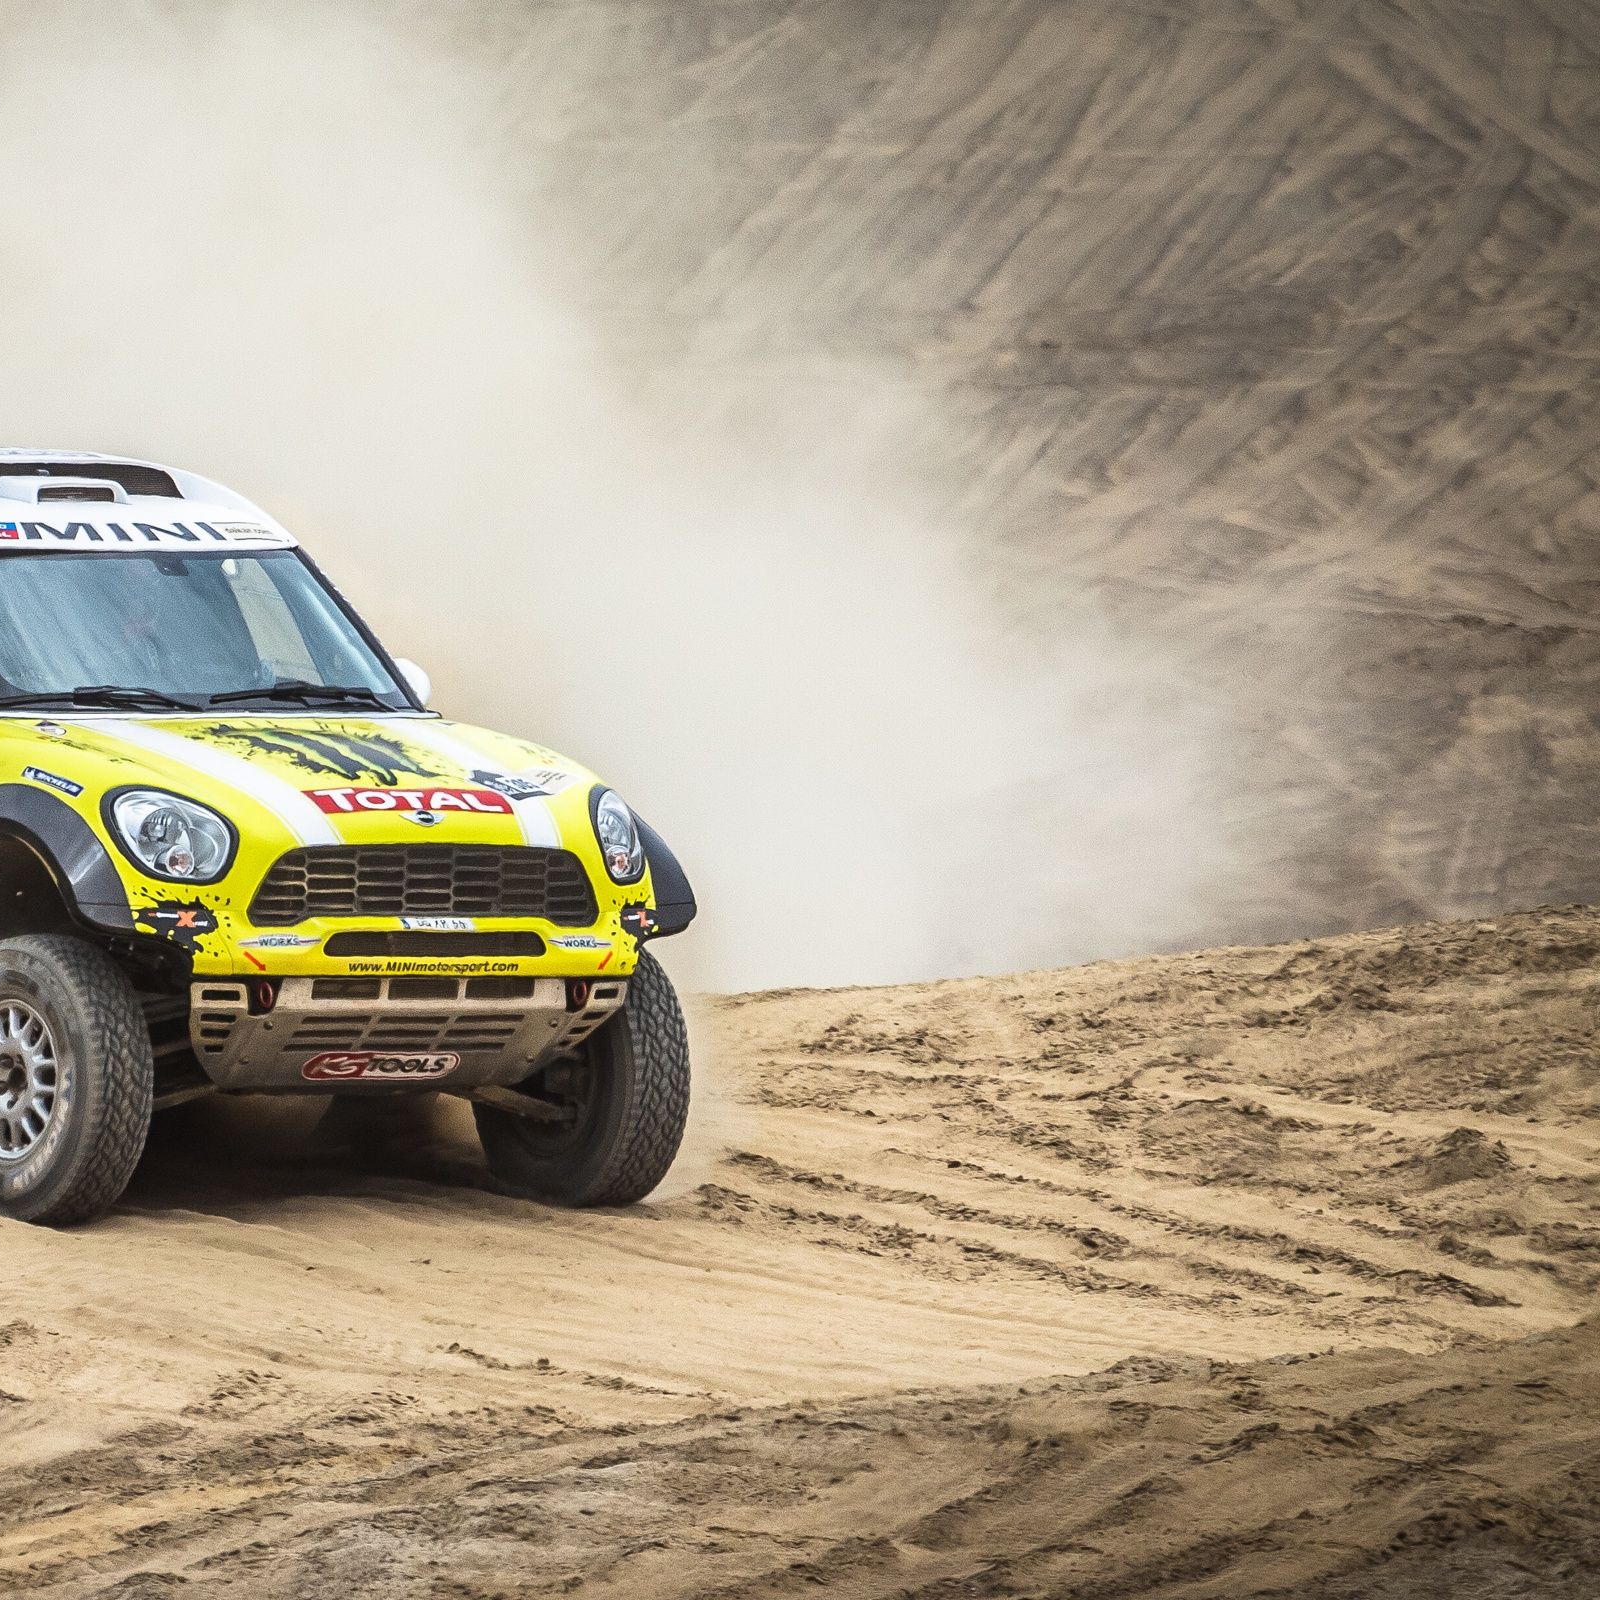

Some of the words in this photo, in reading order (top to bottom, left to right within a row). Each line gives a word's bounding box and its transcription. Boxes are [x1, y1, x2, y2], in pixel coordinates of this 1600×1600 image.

[20, 522, 227, 541] MINI
[312, 788, 505, 812] TOTAL
[259, 937, 300, 947] WORKS
[563, 937, 598, 948] WORKS
[349, 961, 519, 975] www.MINImotorsport.com
[366, 1057, 448, 1073] TOOLS
